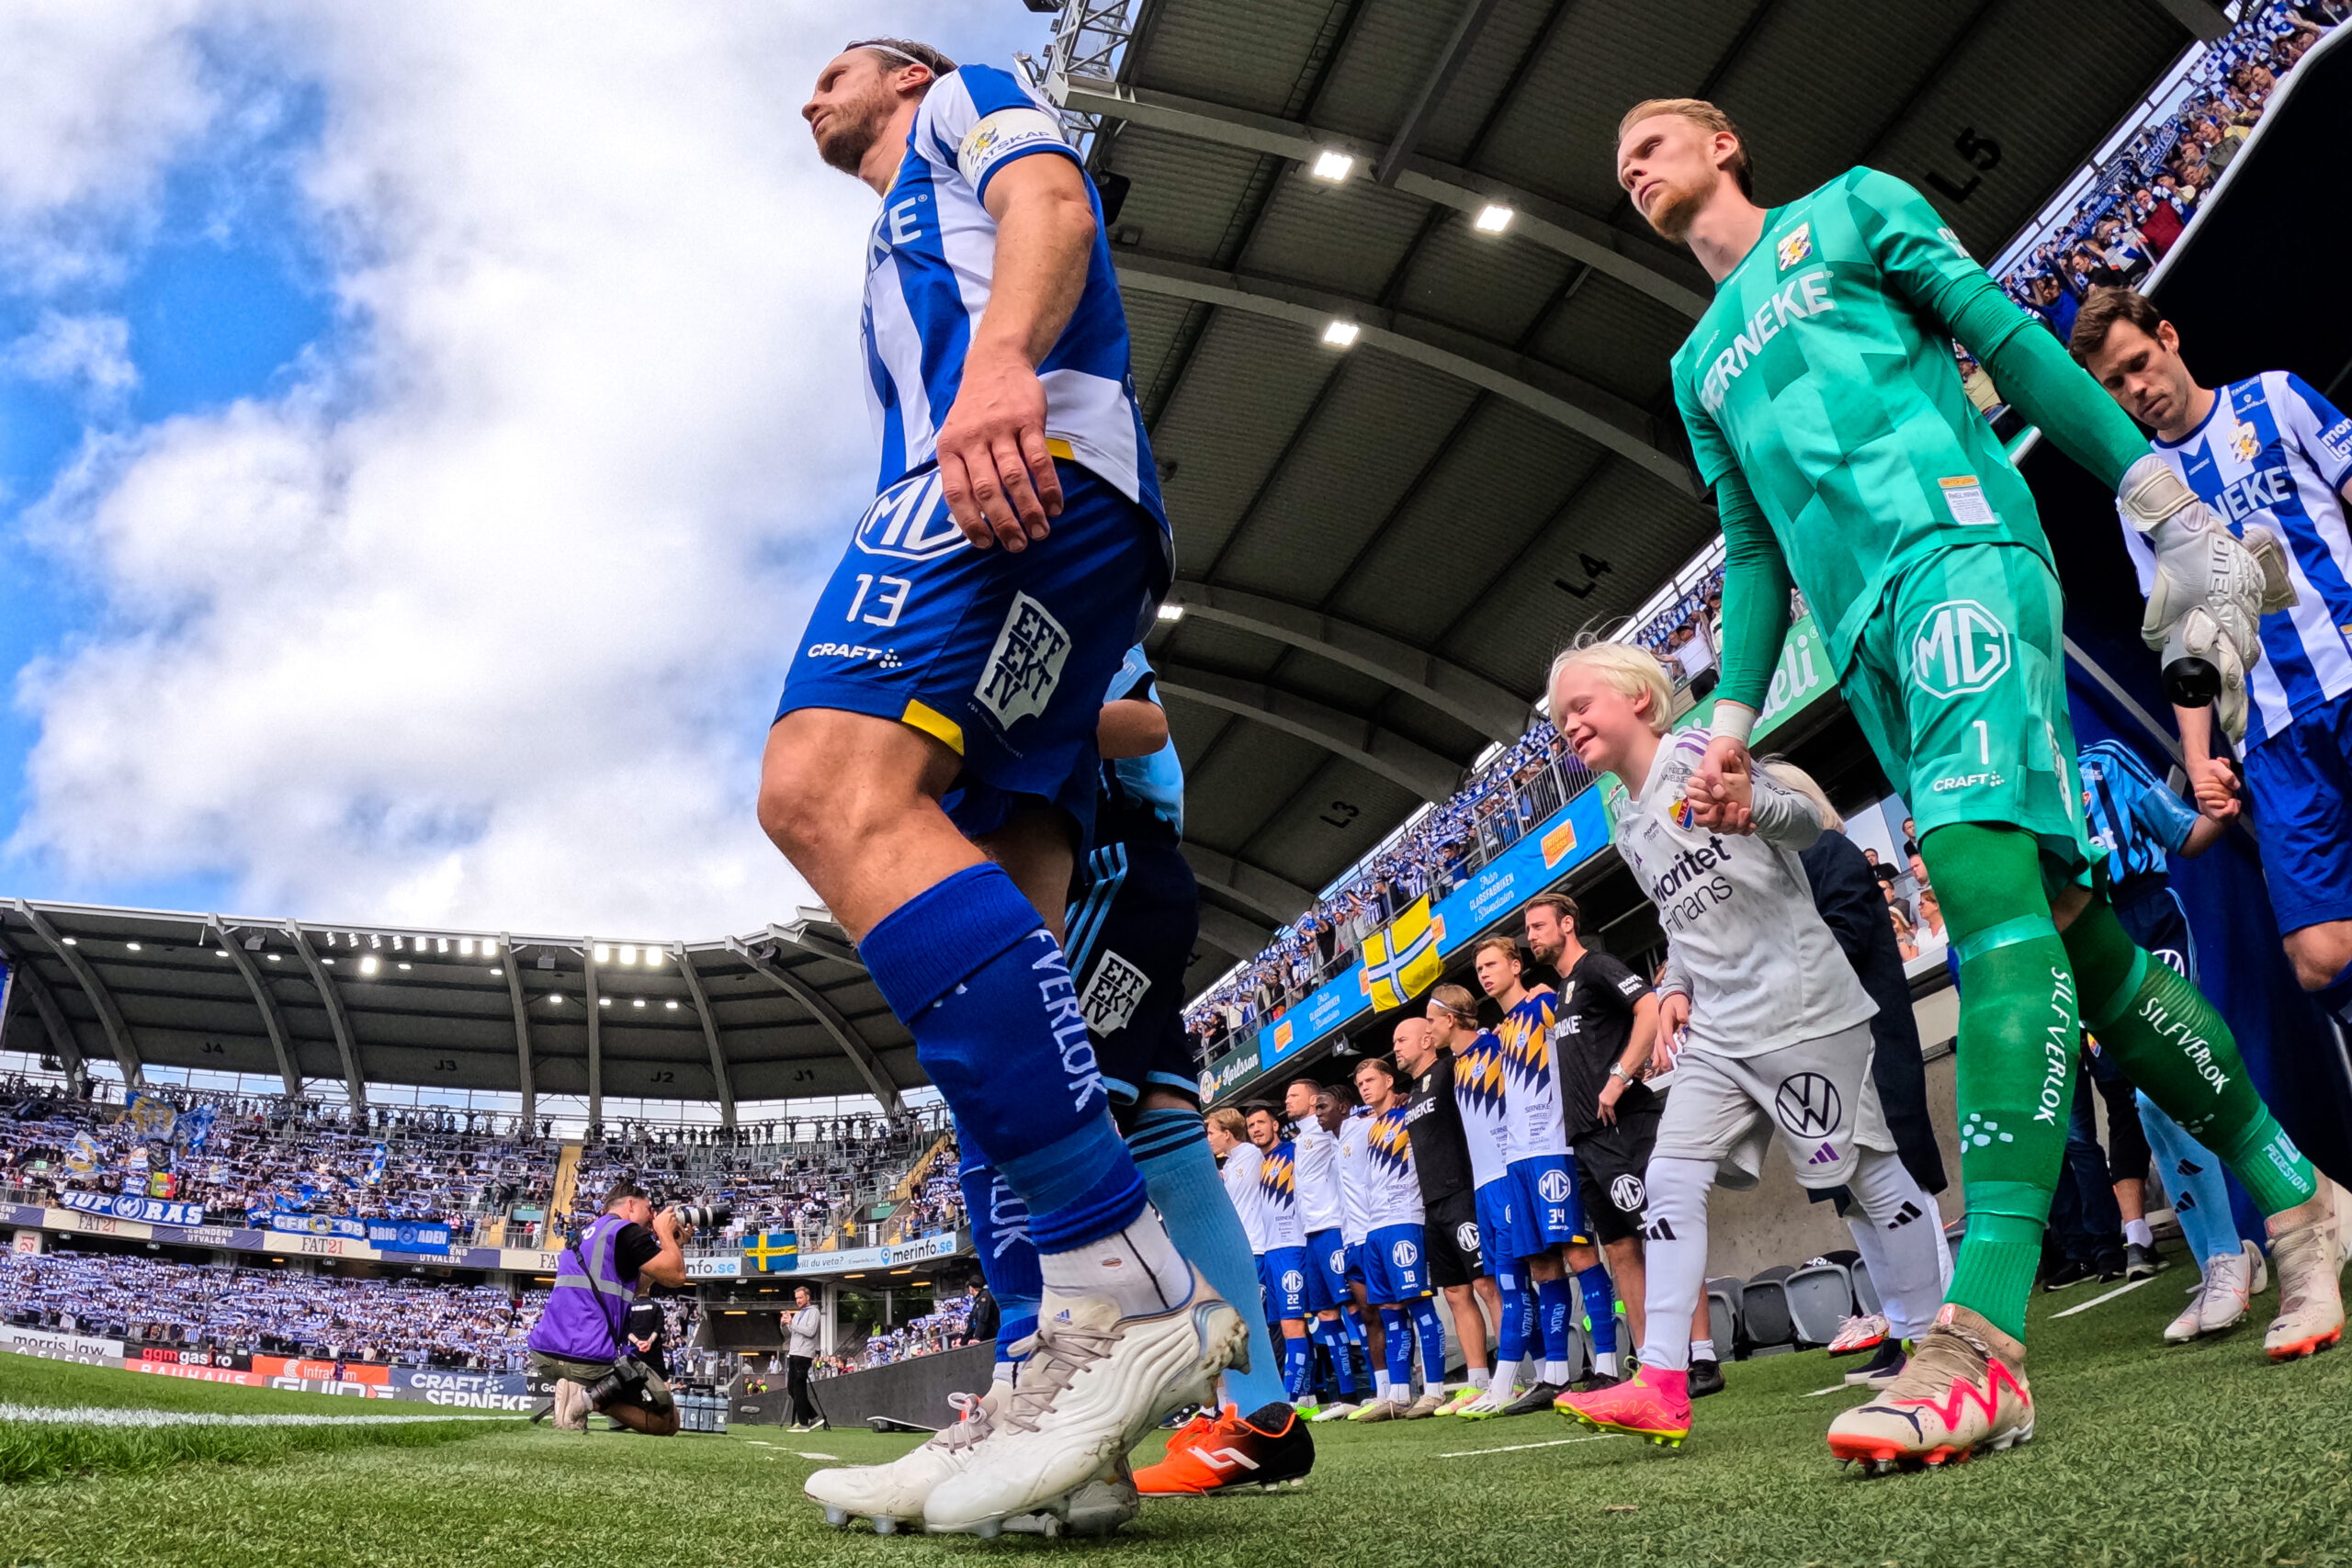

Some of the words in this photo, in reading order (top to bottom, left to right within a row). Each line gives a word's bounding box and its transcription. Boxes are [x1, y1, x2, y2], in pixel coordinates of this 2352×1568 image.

[1924, 127, 2001, 204] L5
[1554, 553, 1611, 599] L4
[845, 573, 912, 627] 13
[808, 642, 883, 660] CRAFT
[1917, 605, 2003, 689] MG
[1973, 720, 1989, 765] 1
[1932, 773, 1990, 792] CRAFT
[1319, 801, 1359, 829] L3
[1470, 873, 1515, 912] GLASSFABRIKEN
[200, 1042, 225, 1055] J4
[2032, 966, 2074, 1127] SILFVERLOK
[2138, 997, 2231, 1095] SILFVERLOK
[434, 1059, 458, 1072] J3
[794, 1069, 816, 1082] J1
[1222, 1053, 1260, 1087] Karlsson
[650, 1071, 675, 1083] J2
[1542, 1172, 1569, 1201] MG
[1613, 1177, 1643, 1208] MG
[62, 1190, 114, 1213] SUP
[142, 1201, 203, 1225] RAS
[1547, 1209, 1565, 1224] 34
[77, 1214, 118, 1235] FAT21
[273, 1214, 311, 1231] GEK
[301, 1236, 345, 1255] FAT21
[369, 1226, 398, 1241] BRIG
[416, 1229, 448, 1246] ADEN
[892, 1239, 954, 1263] merinfo.se
[1394, 1242, 1416, 1266] MG
[810, 1258, 820, 1268] du
[1283, 1271, 1303, 1292] MG
[1403, 1270, 1416, 1283] 18
[1286, 1293, 1299, 1305] 22
[13, 1334, 66, 1351] morris
[411, 1372, 486, 1391] CRAFT
